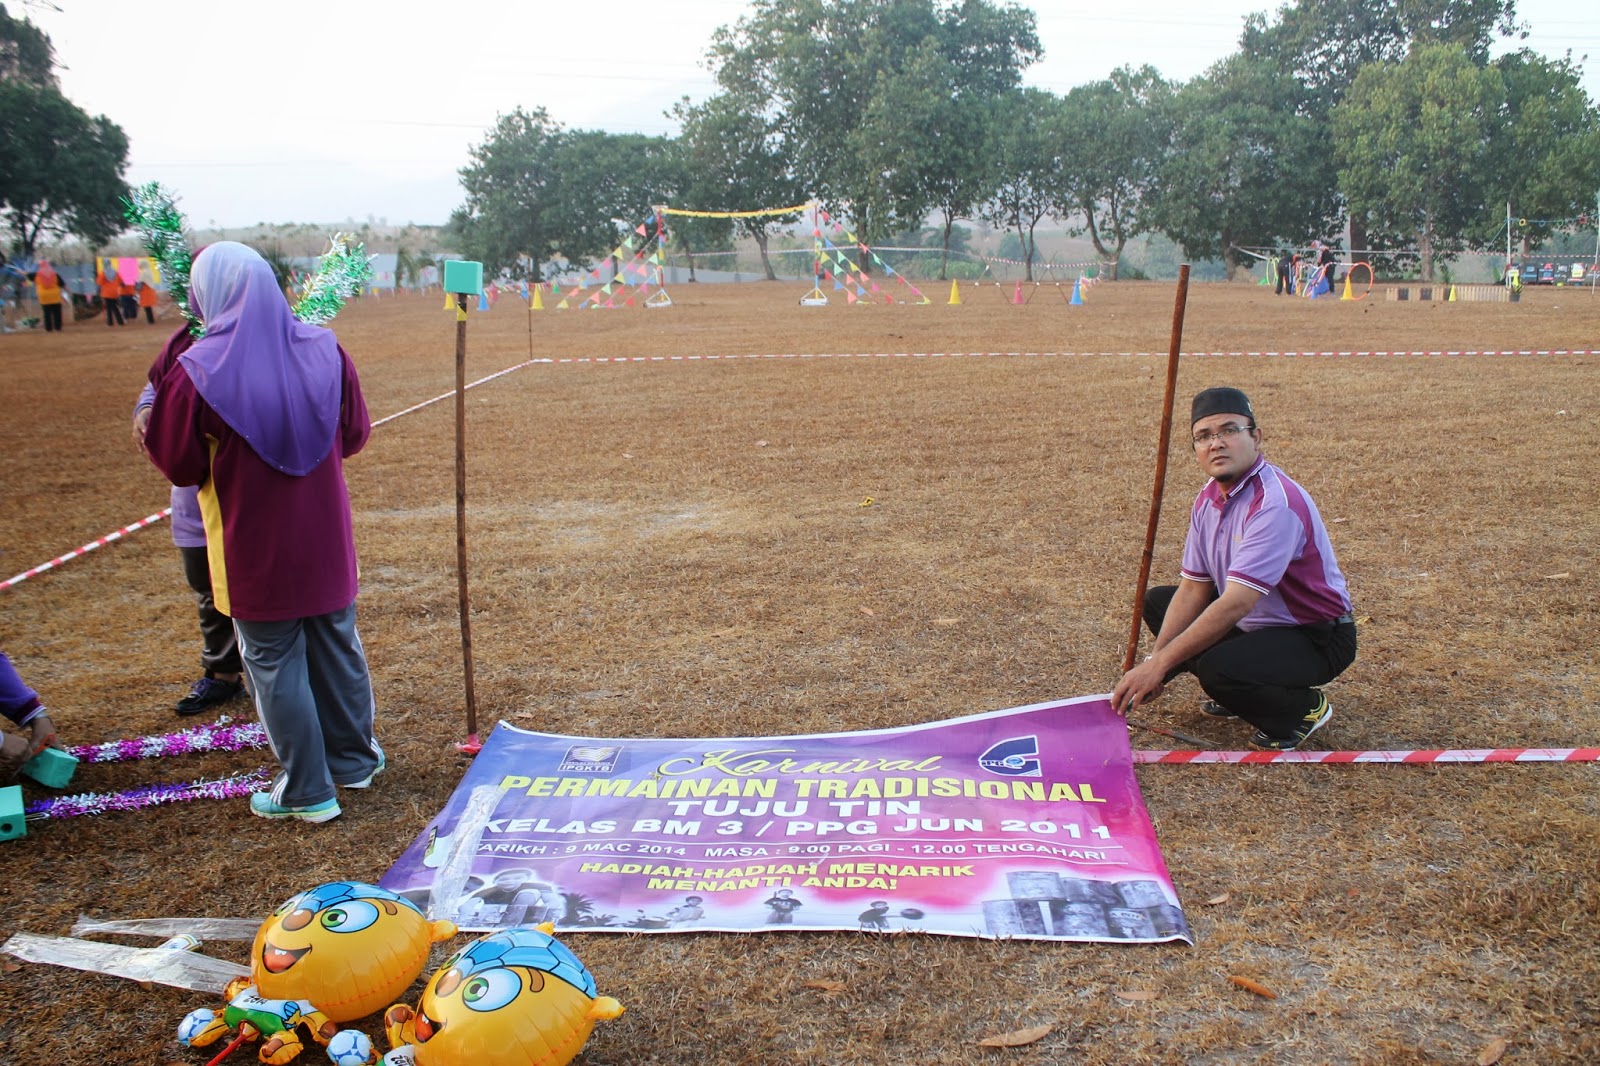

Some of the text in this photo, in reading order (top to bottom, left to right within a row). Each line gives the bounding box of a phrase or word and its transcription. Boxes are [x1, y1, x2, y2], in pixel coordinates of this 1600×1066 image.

[657, 749, 943, 777] Karnival
[499, 775, 1107, 803] PERMAINAN TRADISIONAL
[668, 800, 921, 817] TUJU TIN
[484, 818, 617, 834] KELAS
[631, 819, 702, 836] BM
[716, 821, 743, 835] 3
[785, 821, 877, 836] PPG
[894, 819, 983, 833] JUN
[1000, 819, 1111, 839] 2011
[477, 843, 547, 854] ARIKH
[565, 845, 577, 854] 9
[583, 843, 632, 853] MAC
[637, 844, 686, 855] 2014
[704, 848, 769, 857] MASA
[788, 844, 831, 853] 9.00
[838, 843, 890, 853] PAGI
[911, 844, 966, 854] 12.00
[972, 843, 1106, 860] TENGAHARI
[579, 862, 976, 879] HADIAH-HADIAH MENARIK
[647, 876, 897, 892] MENANTI ANDA!
